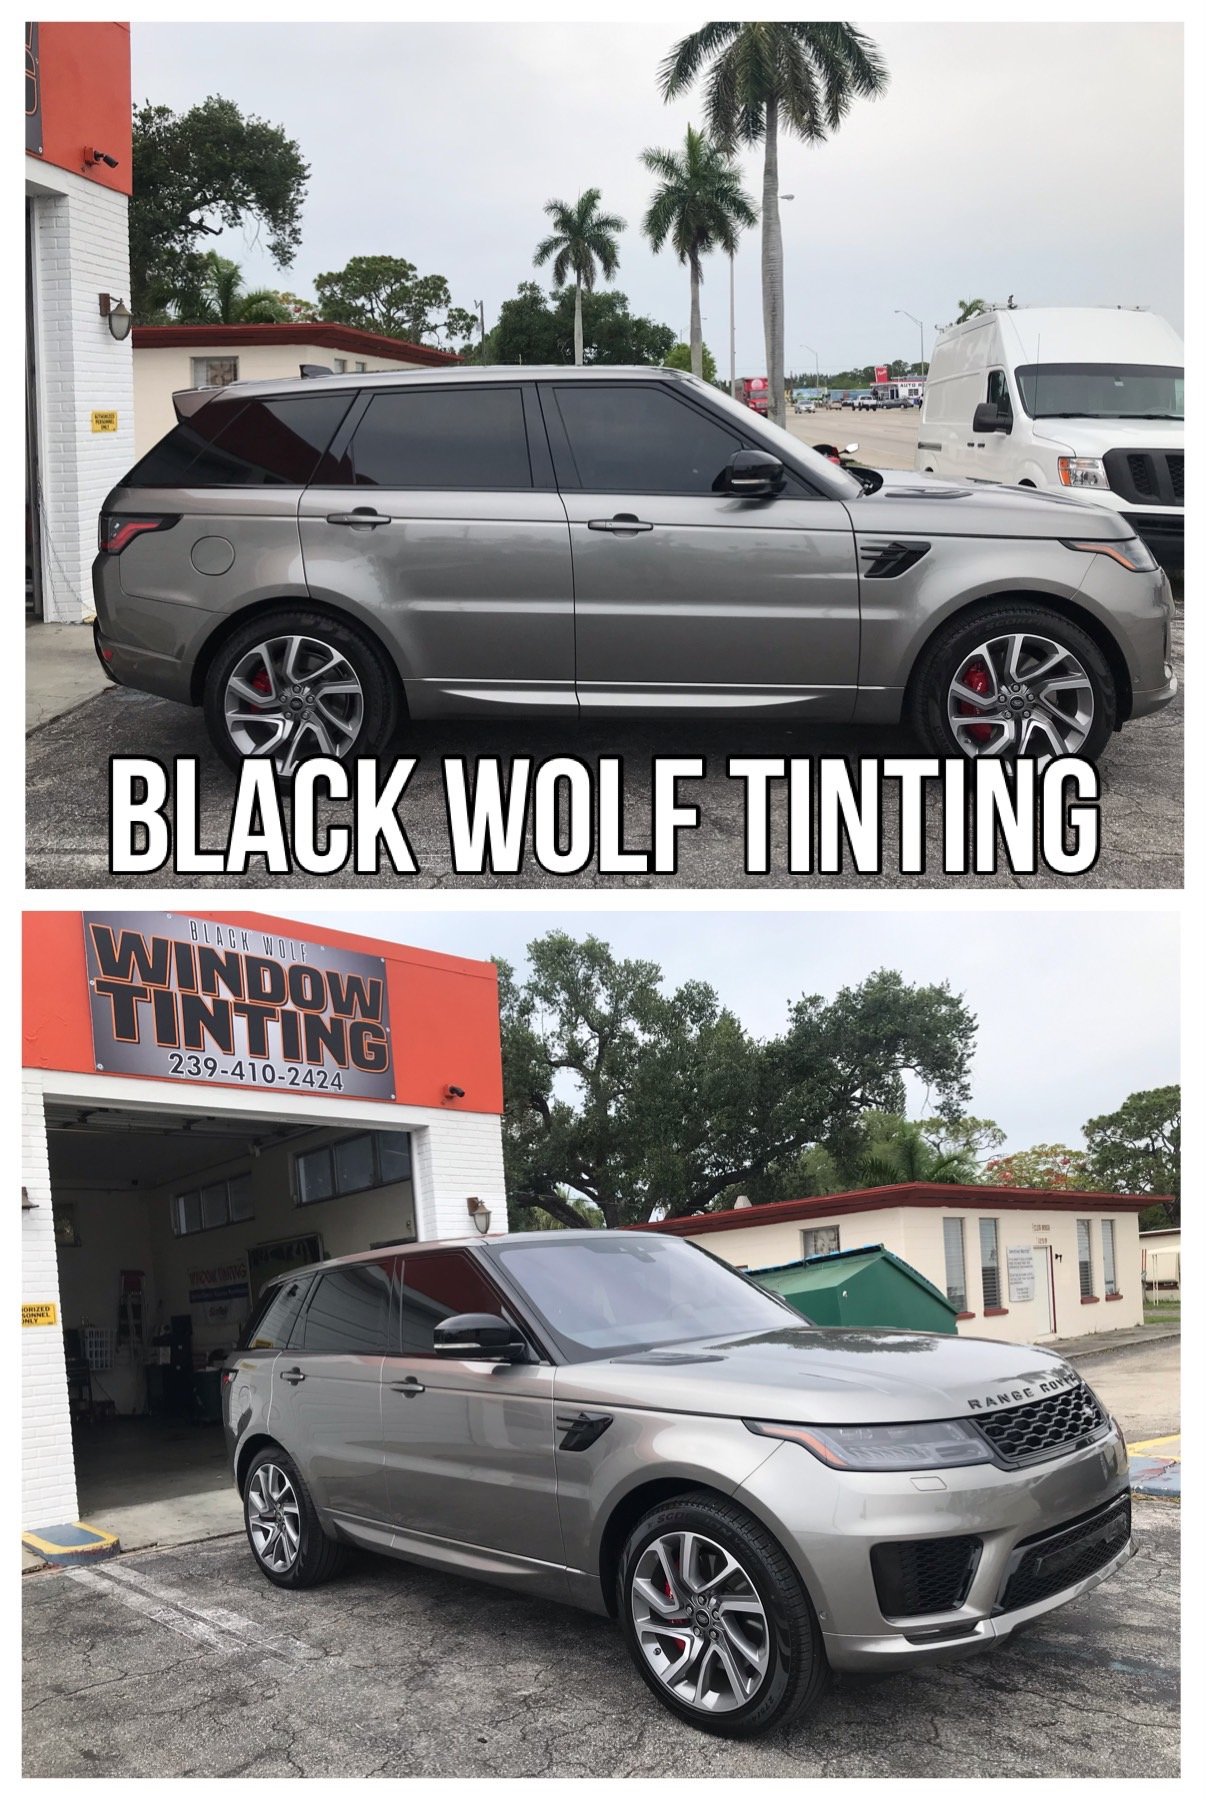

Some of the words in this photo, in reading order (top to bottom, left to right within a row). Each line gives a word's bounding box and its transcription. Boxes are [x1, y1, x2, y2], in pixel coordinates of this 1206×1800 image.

[190, 919, 250, 952] BLACK
[263, 934, 308, 962] WOLF
[89, 922, 384, 1021] WINDOW
[95, 979, 390, 1074] TINTING
[168, 1052, 344, 1091] 239-410-2424
[967, 1387, 1035, 1410] RANGE
